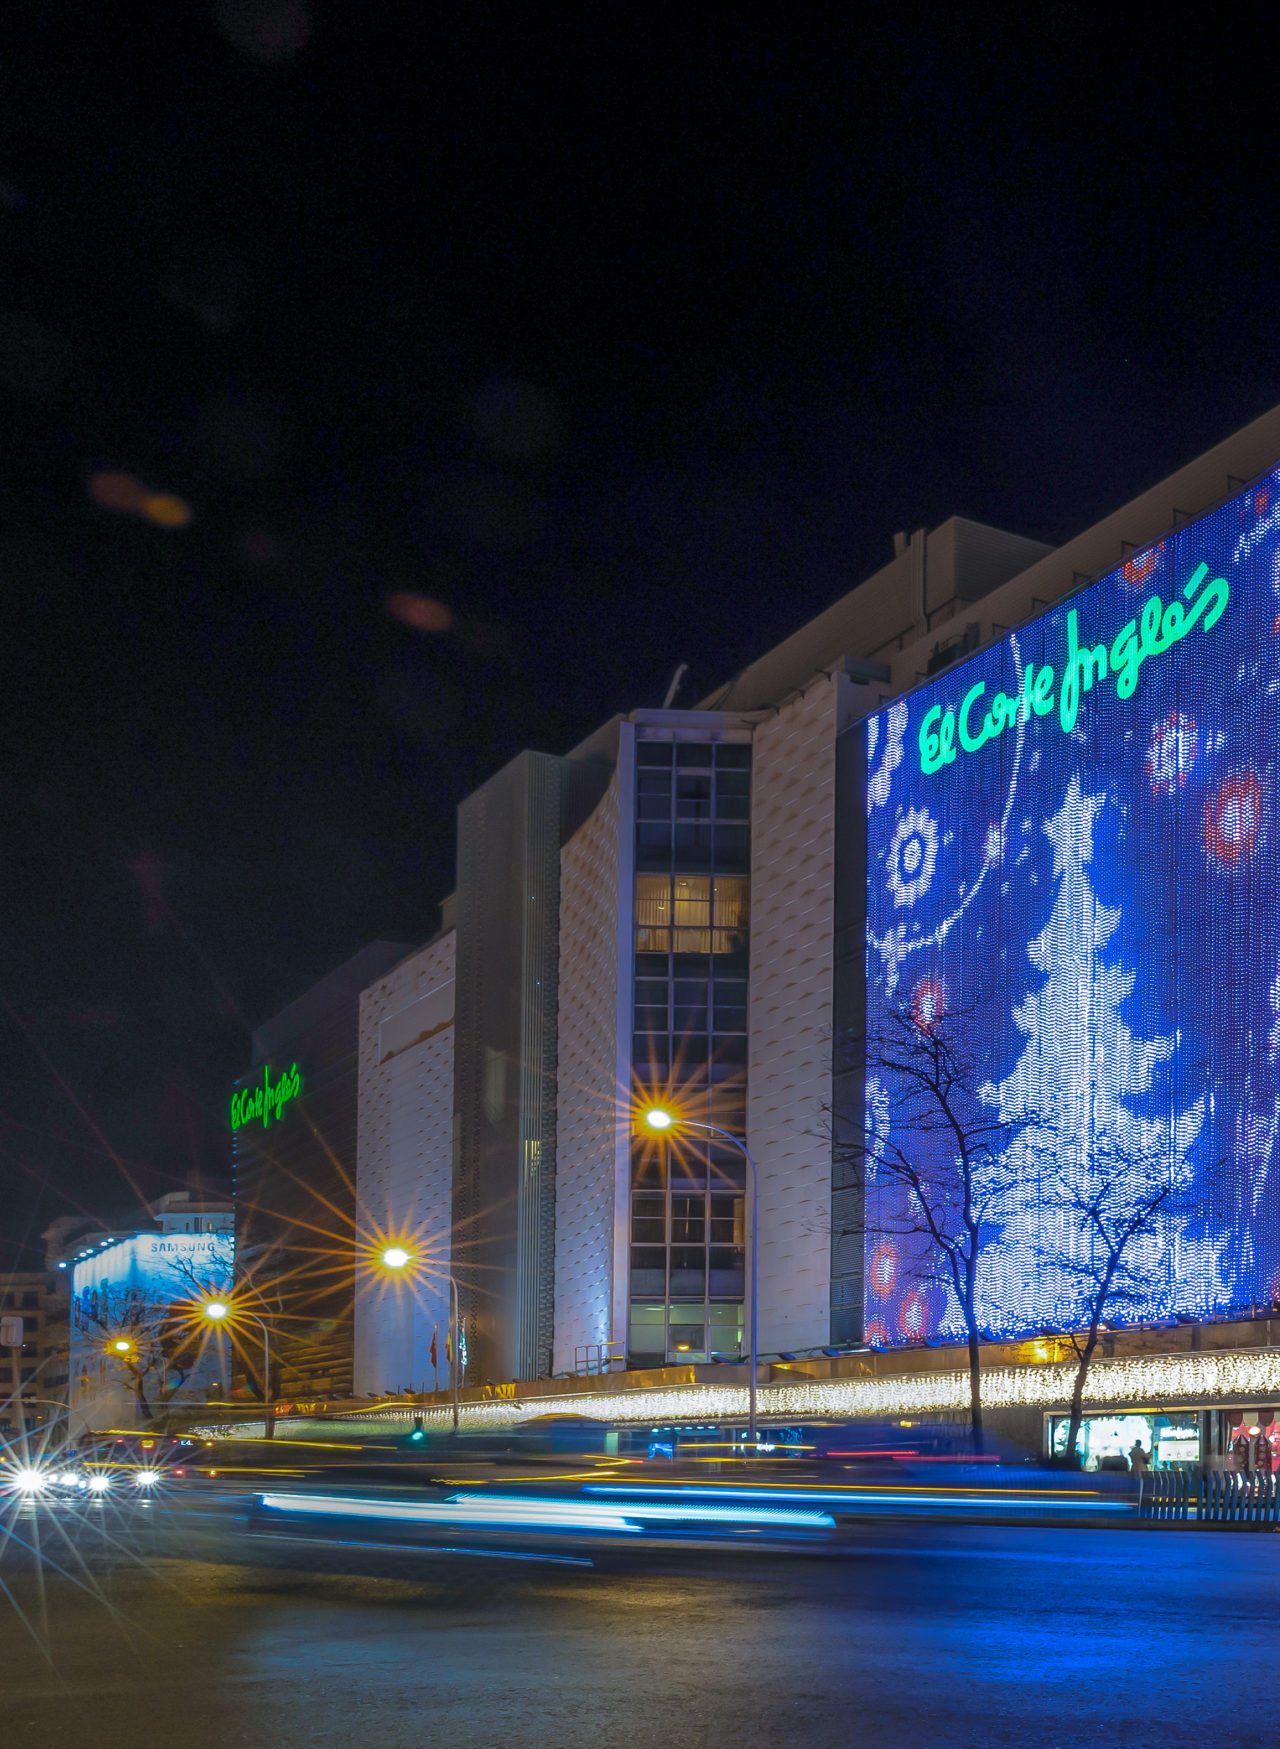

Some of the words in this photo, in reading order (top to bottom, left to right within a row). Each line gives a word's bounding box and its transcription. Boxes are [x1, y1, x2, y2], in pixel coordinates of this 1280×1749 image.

[919, 704, 956, 775] El
[959, 662, 1055, 752] Corte
[1060, 561, 1230, 733] Inglés
[151, 1242, 216, 1253] SAMSUNG
